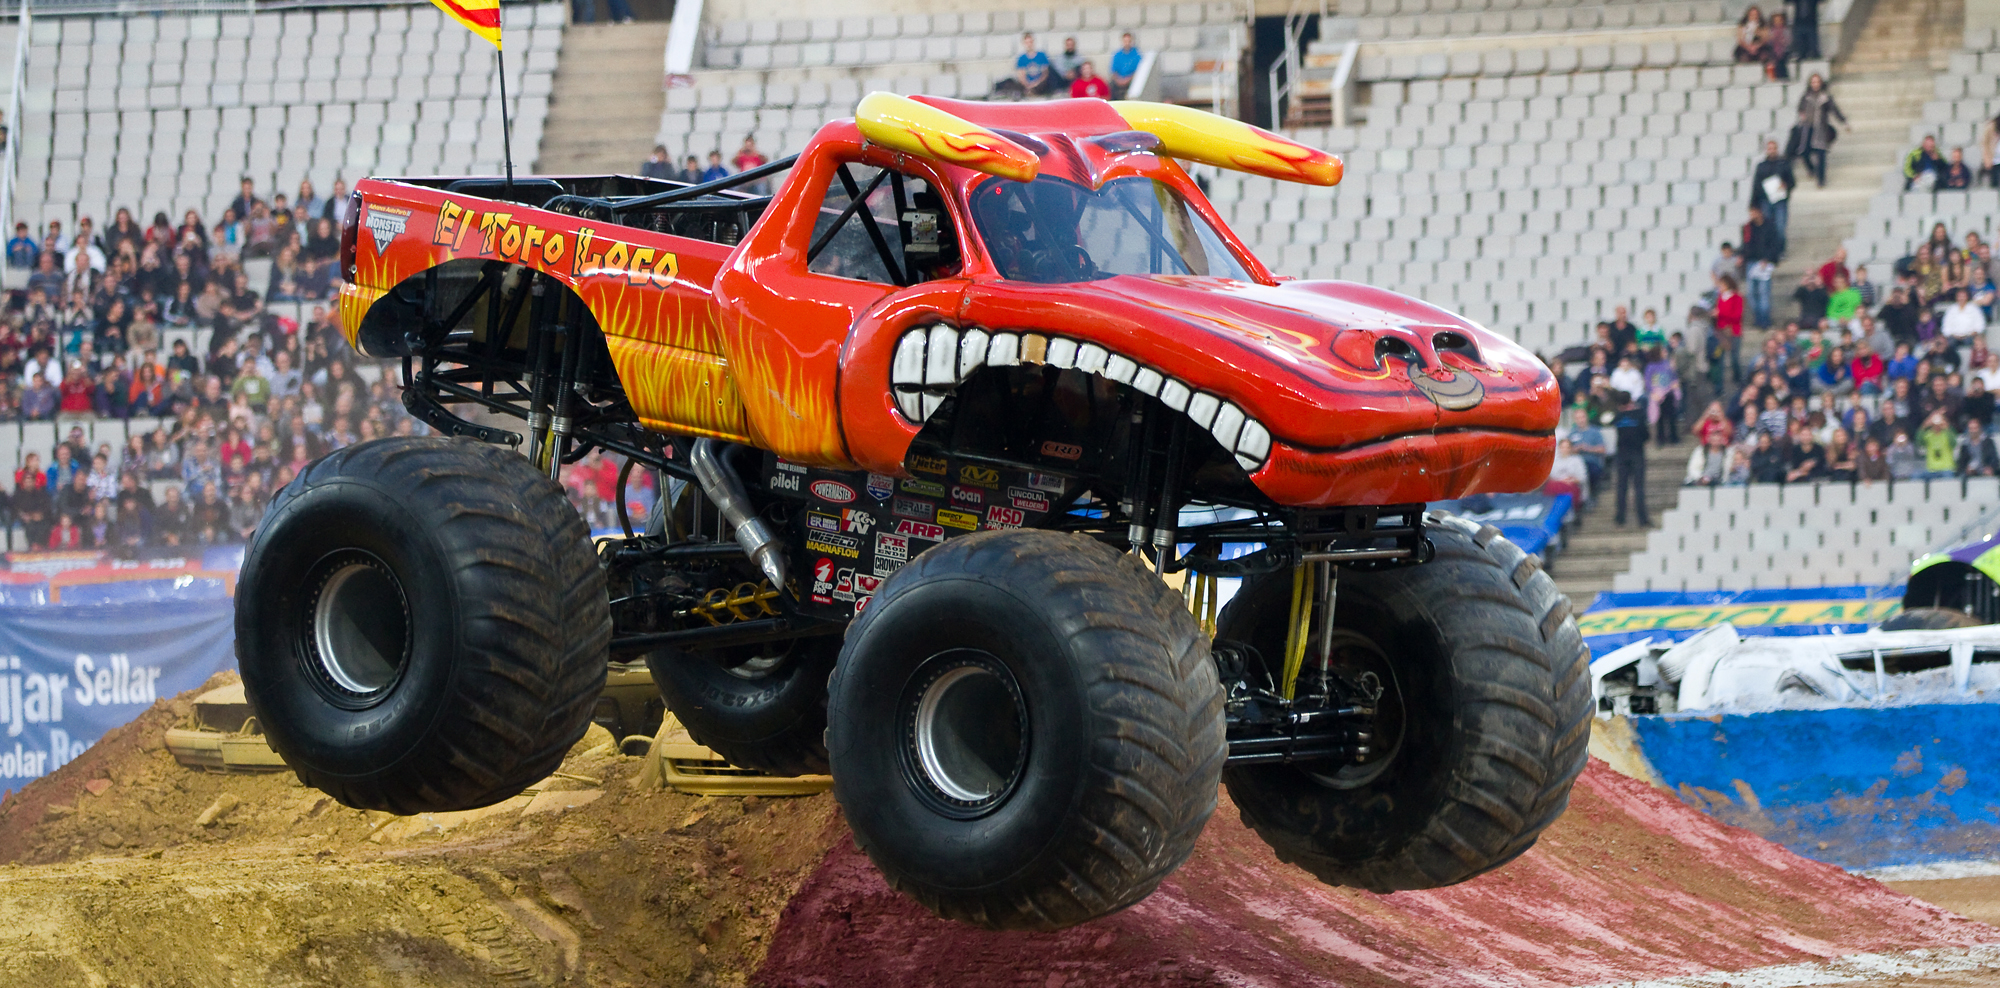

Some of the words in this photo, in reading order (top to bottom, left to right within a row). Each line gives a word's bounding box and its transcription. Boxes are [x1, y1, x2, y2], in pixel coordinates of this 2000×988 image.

[365, 216, 406, 234] MONSTER
[433, 199, 474, 252] El
[477, 212, 565, 266] Toro
[373, 229, 395, 242] JAM
[769, 472, 800, 491] piloti
[815, 483, 852, 500] POWERMASTER
[952, 486, 981, 503] Coan
[1010, 489, 1042, 500] LINCOLN
[896, 499, 931, 514] DERALE
[1016, 500, 1045, 510] WELDERS
[939, 511, 963, 520] ENERGY
[988, 506, 1023, 525] MSD
[897, 520, 943, 538] ARP
[806, 540, 860, 559] MAGNAFLOW
[877, 549, 905, 558] ENDS
[813, 586, 827, 595] PRO
[814, 580, 833, 590] SPEED
[74, 653, 162, 708] Sellar
